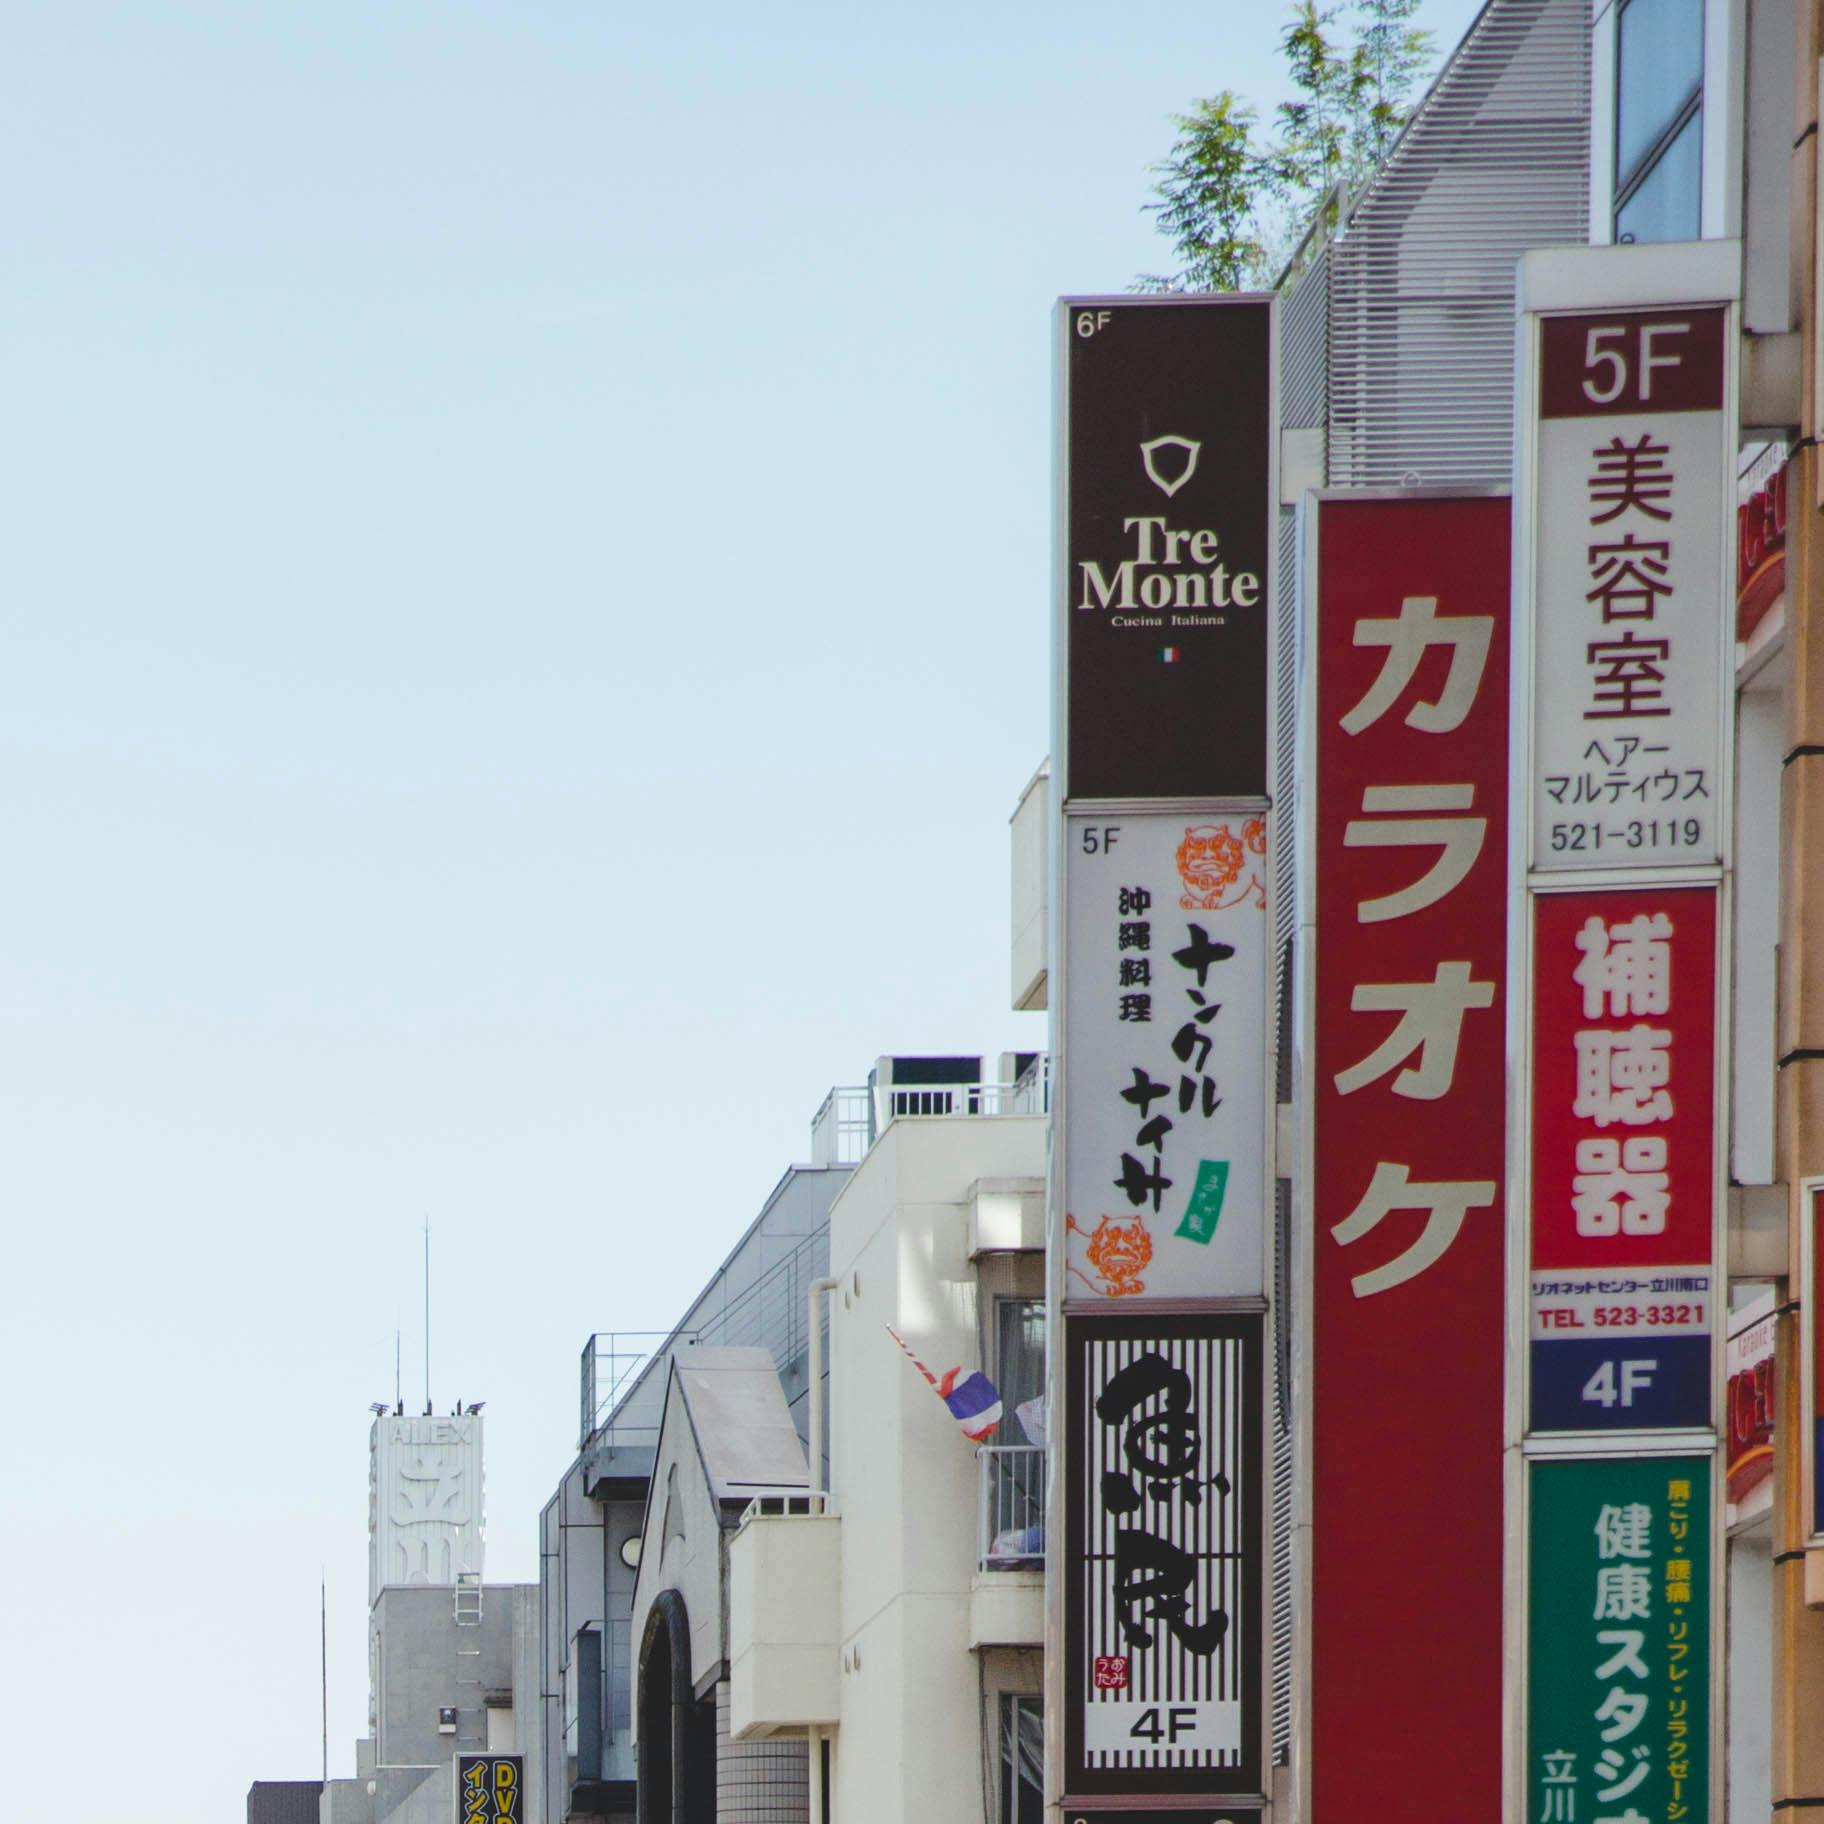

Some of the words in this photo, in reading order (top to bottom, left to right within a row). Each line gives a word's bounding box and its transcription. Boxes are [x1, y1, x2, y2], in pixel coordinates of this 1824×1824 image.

[1076, 311, 1112, 339] 6F
[1581, 322, 1691, 404] 5F
[1122, 515, 1218, 567] Tre
[1076, 561, 1261, 612] Monte
[1583, 432, 1676, 722] 美容室
[1111, 614, 1163, 629] Cucina
[1170, 613, 1226, 628] Italiana
[1582, 736, 1670, 770] ヘアー
[1544, 767, 1711, 807] マルティウス
[1081, 826, 1121, 856] 5F
[1549, 820, 1702, 854] 521-3119
[1117, 885, 1153, 1023] 沖縄料理
[1330, 595, 1498, 1300] カラオケ
[1571, 910, 1676, 1238] 補聴器
[1537, 1306, 1585, 1330] TEL
[1592, 1304, 1707, 1330] 523-3321
[1580, 1359, 1659, 1409] 4F
[1095, 1351, 1231, 1657] 魚民
[1129, 1706, 1198, 1745] 4F
